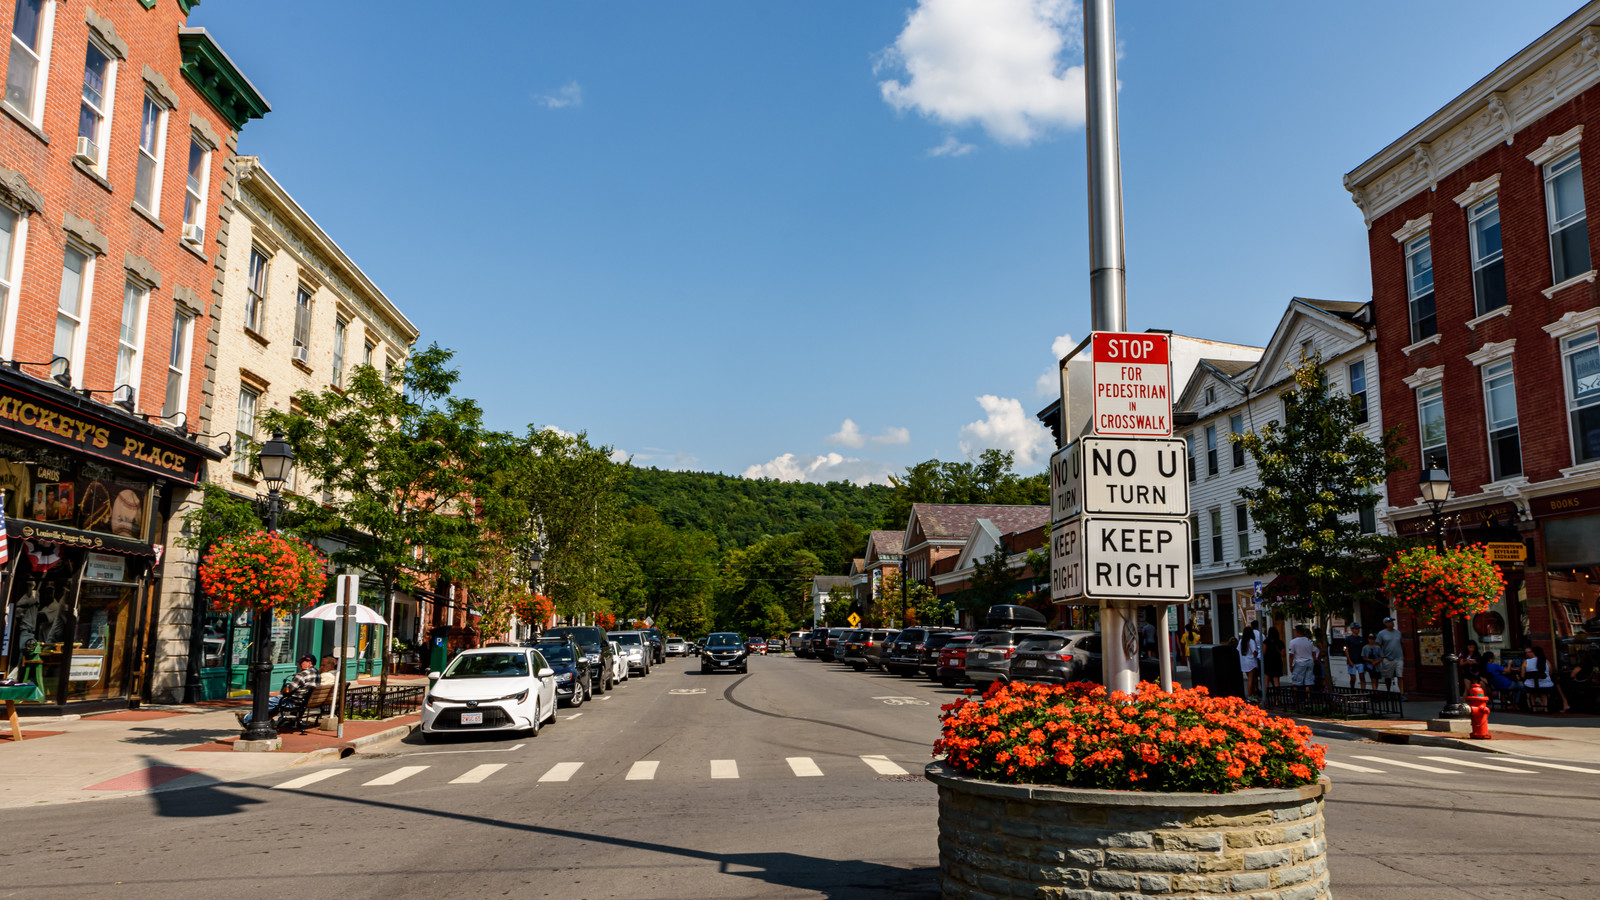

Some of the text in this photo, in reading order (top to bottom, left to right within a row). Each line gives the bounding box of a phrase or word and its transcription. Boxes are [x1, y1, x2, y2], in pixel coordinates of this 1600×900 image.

[1108, 339, 1154, 358] STOP
[1121, 366, 1142, 381] FOR
[1098, 383, 1166, 399] PEDESTRIAN
[1129, 401, 1136, 411] IN
[1101, 414, 1165, 430] CROSSWALK
[122, 436, 186, 473] PLACE
[1093, 448, 1177, 478] NO U
[37, 466, 60, 482] CARDS
[1054, 452, 1080, 490] NO U
[1058, 487, 1077, 513] TURN
[1106, 484, 1166, 505] TURN
[1550, 497, 1581, 511] BOOKS
[1054, 530, 1077, 559] KEEP
[1101, 528, 1173, 554] KEEP
[1053, 563, 1079, 592] RIGHT
[1096, 562, 1179, 588] RIGHT
[436, 637, 443, 646] P
